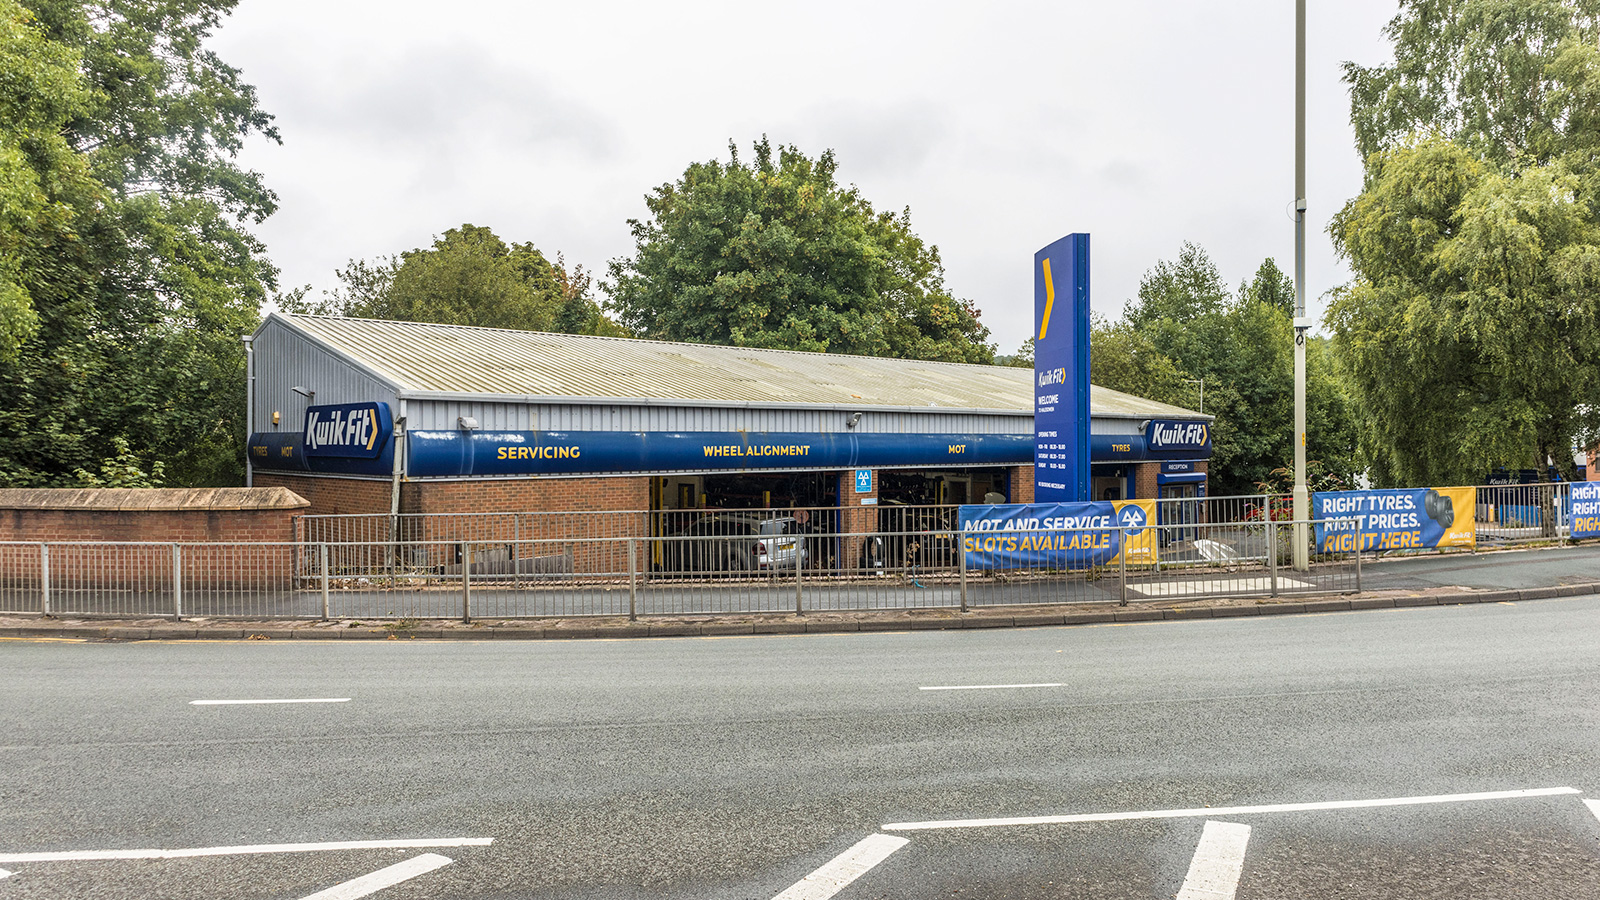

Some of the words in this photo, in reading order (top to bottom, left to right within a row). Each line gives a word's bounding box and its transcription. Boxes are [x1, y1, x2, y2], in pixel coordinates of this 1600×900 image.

[1053, 367, 1063, 384] Fit
[1038, 394, 1059, 405] WELCOME
[305, 410, 346, 449] Kwik
[349, 409, 370, 446] Fit
[1152, 423, 1185, 447] Kwik
[1185, 424, 1202, 444] Fit
[253, 445, 268, 457] TYRES
[281, 446, 293, 457] MOT
[497, 446, 580, 460] SERVICING
[703, 445, 744, 457] WHEEL
[746, 445, 810, 457] ALIGNMENT
[948, 445, 966, 454] MOT
[1112, 444, 1131, 453] TYRES
[1322, 496, 1366, 513] RIGHT
[1367, 494, 1416, 511] TYRES.
[965, 519, 1002, 532] MOT
[1004, 517, 1039, 531] AND
[1043, 515, 1110, 530] SERVICE
[1324, 515, 1366, 532] RIGHT
[1368, 513, 1421, 530] PRICES.
[964, 536, 1017, 552] SLOTS
[1020, 533, 1110, 550] AVAILABLE
[1323, 533, 1378, 552] RIGHT
[1378, 530, 1424, 549] HERE.
